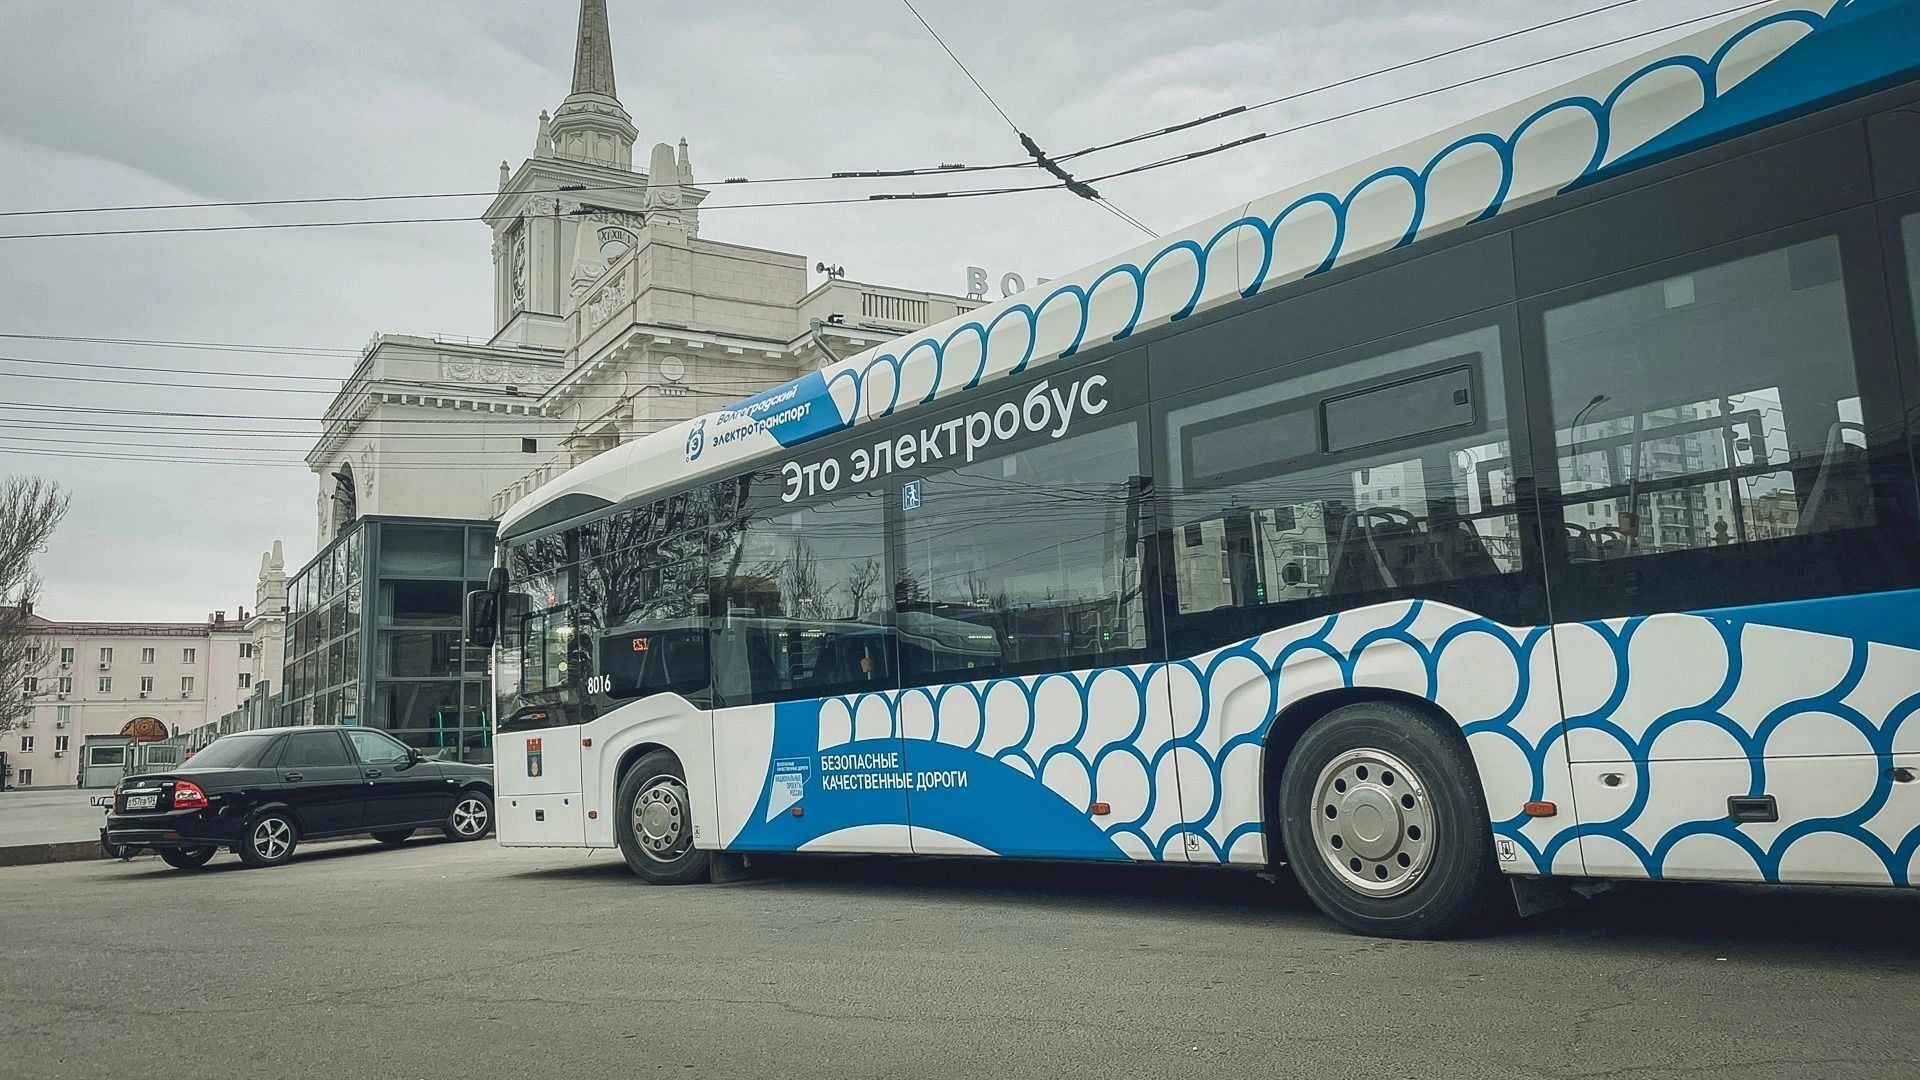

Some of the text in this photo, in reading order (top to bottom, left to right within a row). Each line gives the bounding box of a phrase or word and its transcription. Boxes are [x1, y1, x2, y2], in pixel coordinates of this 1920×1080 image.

[611, 229, 623, 239] XII
[967, 266, 1052, 297] ВО
[716, 384, 799, 426] Волгоградский
[712, 402, 811, 448] электротранспорт
[781, 374, 1108, 503] Это электробус
[587, 674, 611, 694] 8016
[821, 752, 899, 771] БЕЗОПАСНЫЕ
[822, 771, 968, 792] КАЧЕСТВЕННЫЕ ДОРОГИ
